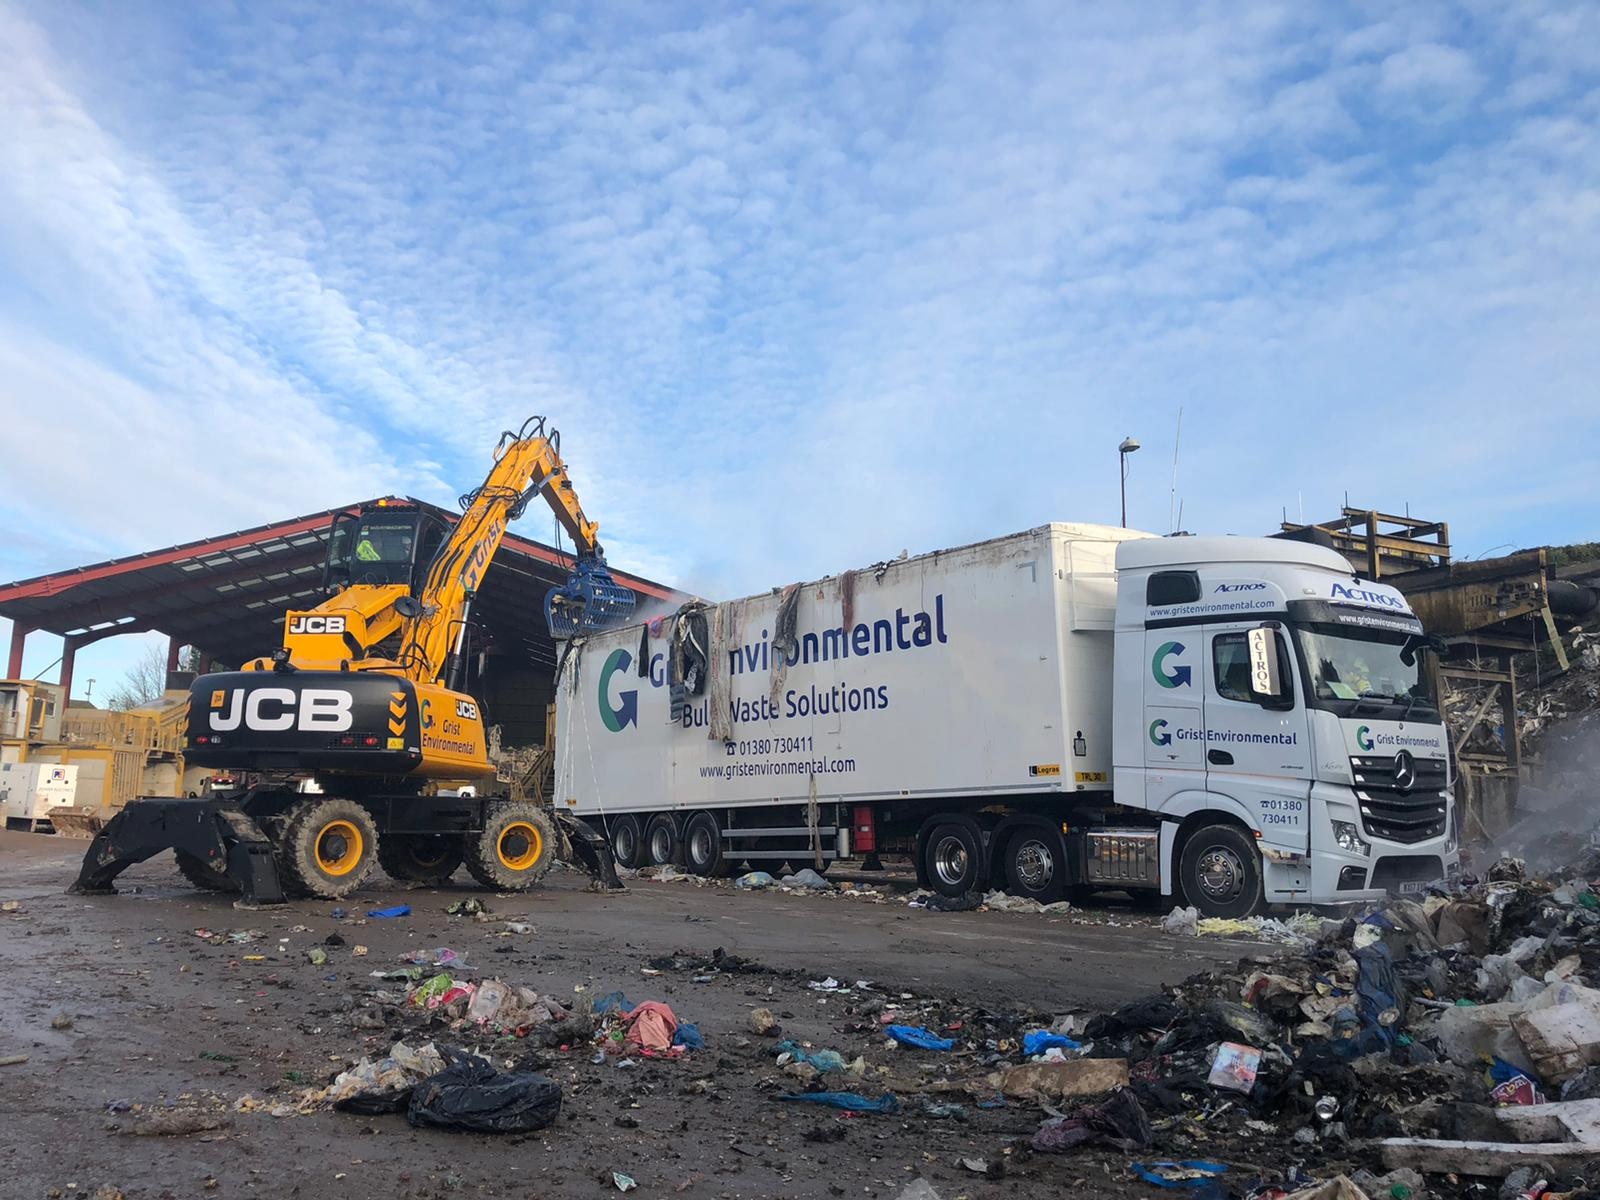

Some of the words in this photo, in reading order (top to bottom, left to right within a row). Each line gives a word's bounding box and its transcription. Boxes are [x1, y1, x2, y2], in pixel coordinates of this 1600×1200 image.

[1214, 583, 1267, 593] ACTROS
[1331, 584, 1403, 608] ACTROS
[1150, 600, 1275, 617] www.gristenvironmental.com
[290, 617, 345, 634] JCB
[1254, 632, 1268, 691] ACTROS
[786, 682, 889, 718] Solutions
[209, 688, 353, 732] JCB
[457, 701, 477, 719] JCB
[442, 720, 461, 736] Grist
[1176, 728, 1204, 740] Grist
[1207, 730, 1297, 745] Environmental
[423, 734, 475, 754] Environmental
[740, 739, 771, 755] 01380
[774, 736, 813, 753] 730411
[1376, 733, 1395, 745] Grist
[1396, 735, 1440, 748] Environmental
[700, 756, 856, 780] www.gristenvironmental.com
[1270, 800, 1302, 811] 01380
[1262, 813, 1298, 825] 730411
